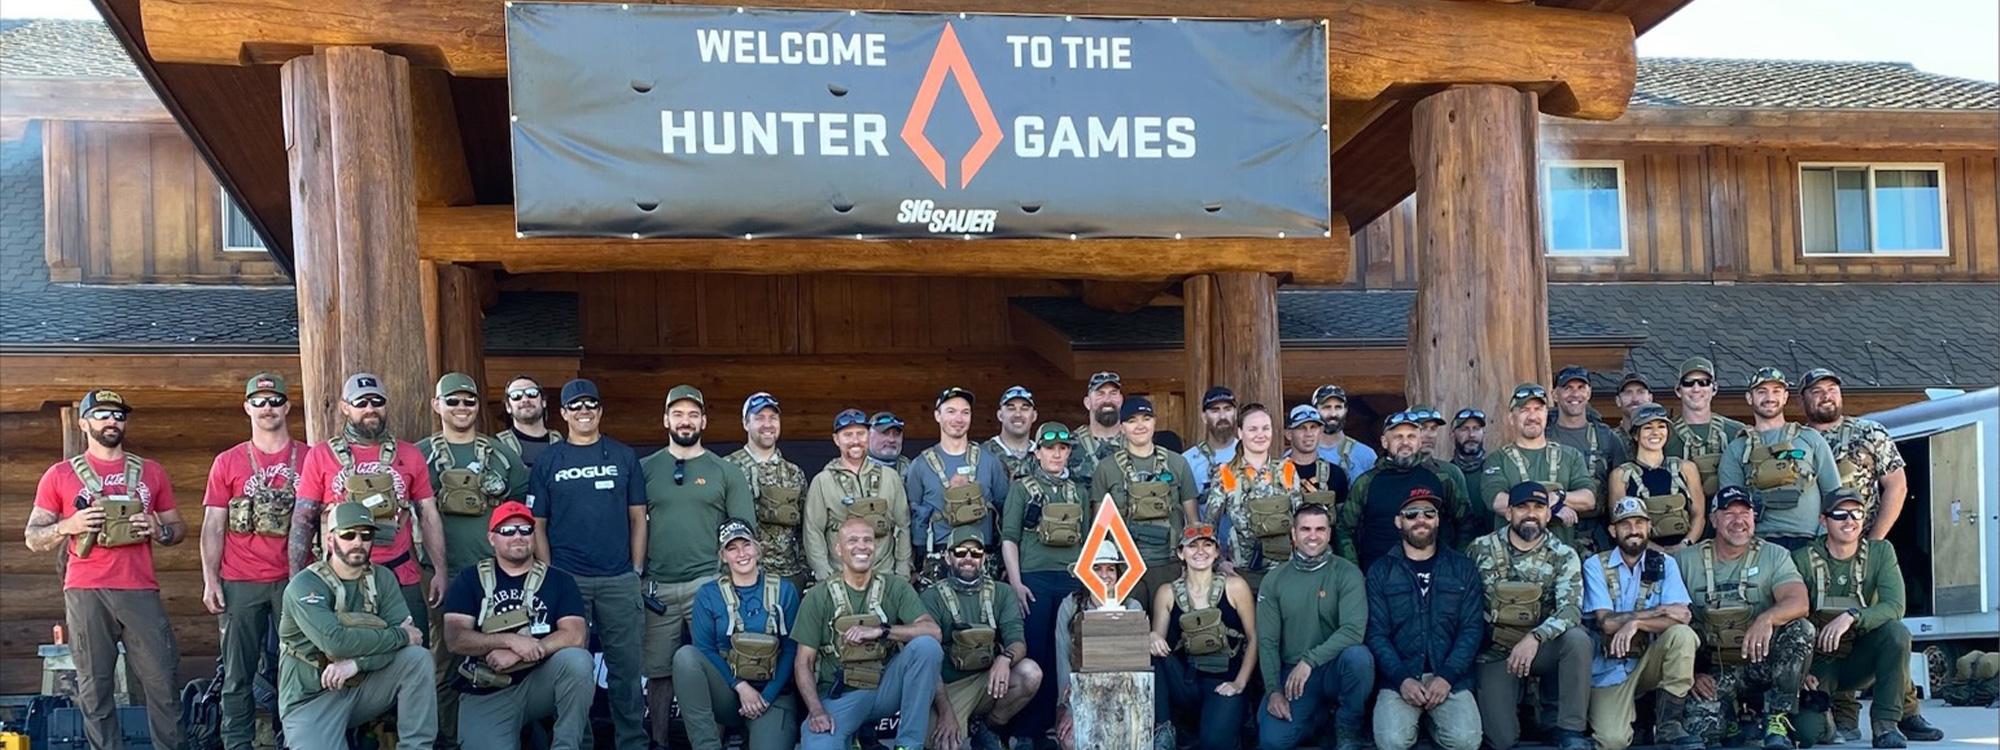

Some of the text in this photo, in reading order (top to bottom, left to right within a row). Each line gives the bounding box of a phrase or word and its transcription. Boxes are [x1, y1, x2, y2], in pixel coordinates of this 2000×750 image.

[697, 29, 1132, 69] WELCOME TO THE
[660, 110, 1197, 159] HUNTER GAMES
[897, 199, 997, 232] SIG SAUER
[555, 465, 618, 482] ROGUE
[493, 588, 548, 611] IBEY
